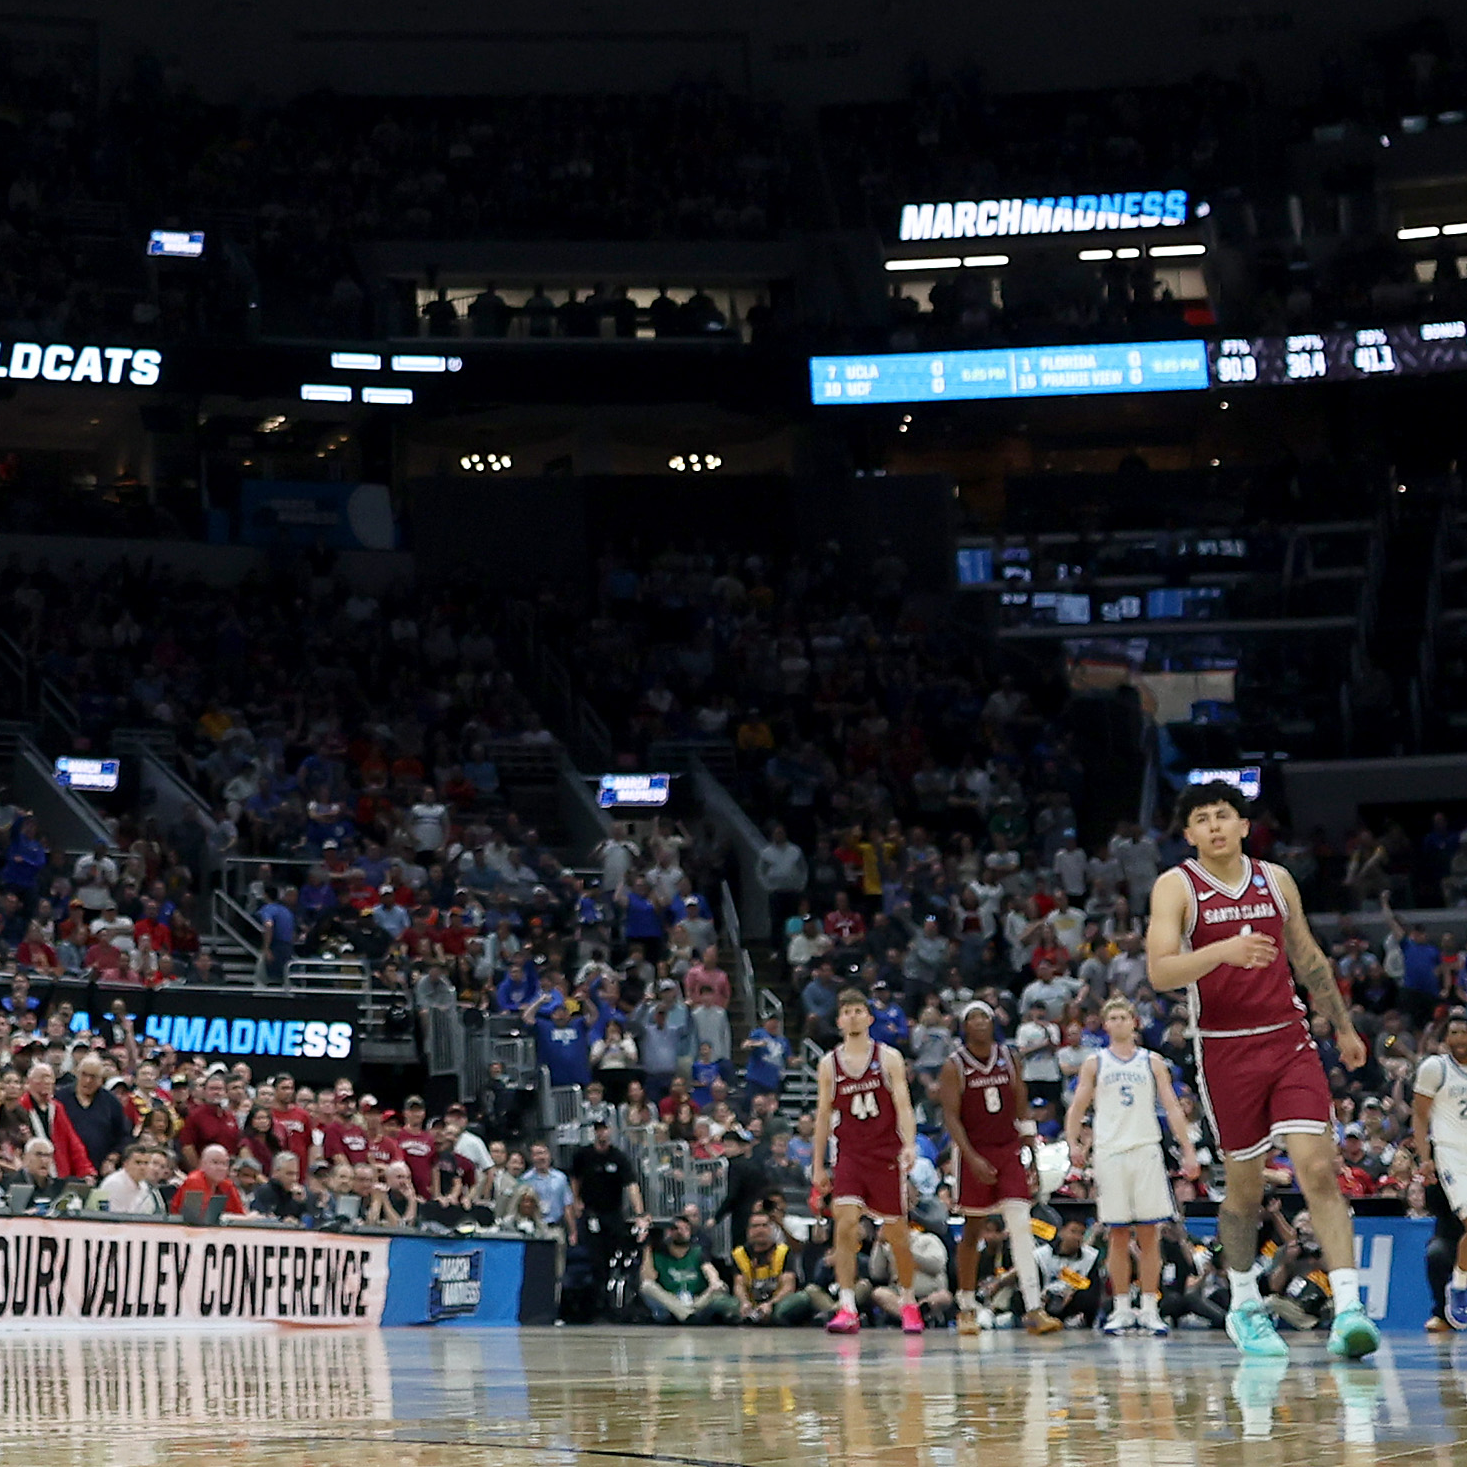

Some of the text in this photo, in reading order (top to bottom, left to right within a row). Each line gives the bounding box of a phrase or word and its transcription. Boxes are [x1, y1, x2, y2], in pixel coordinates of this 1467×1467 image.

[899, 189, 1188, 241] MARCHMADNESS
[845, 363, 880, 380] UCLA
[1039, 353, 1098, 371] FLORIDA
[1202, 901, 1277, 925] SANTA CLARA
[850, 1091, 880, 1121] 44
[1119, 1084, 1135, 1108] 5
[80, 1238, 191, 1319] VALLEY
[200, 1243, 371, 1319] CONFERENCE
